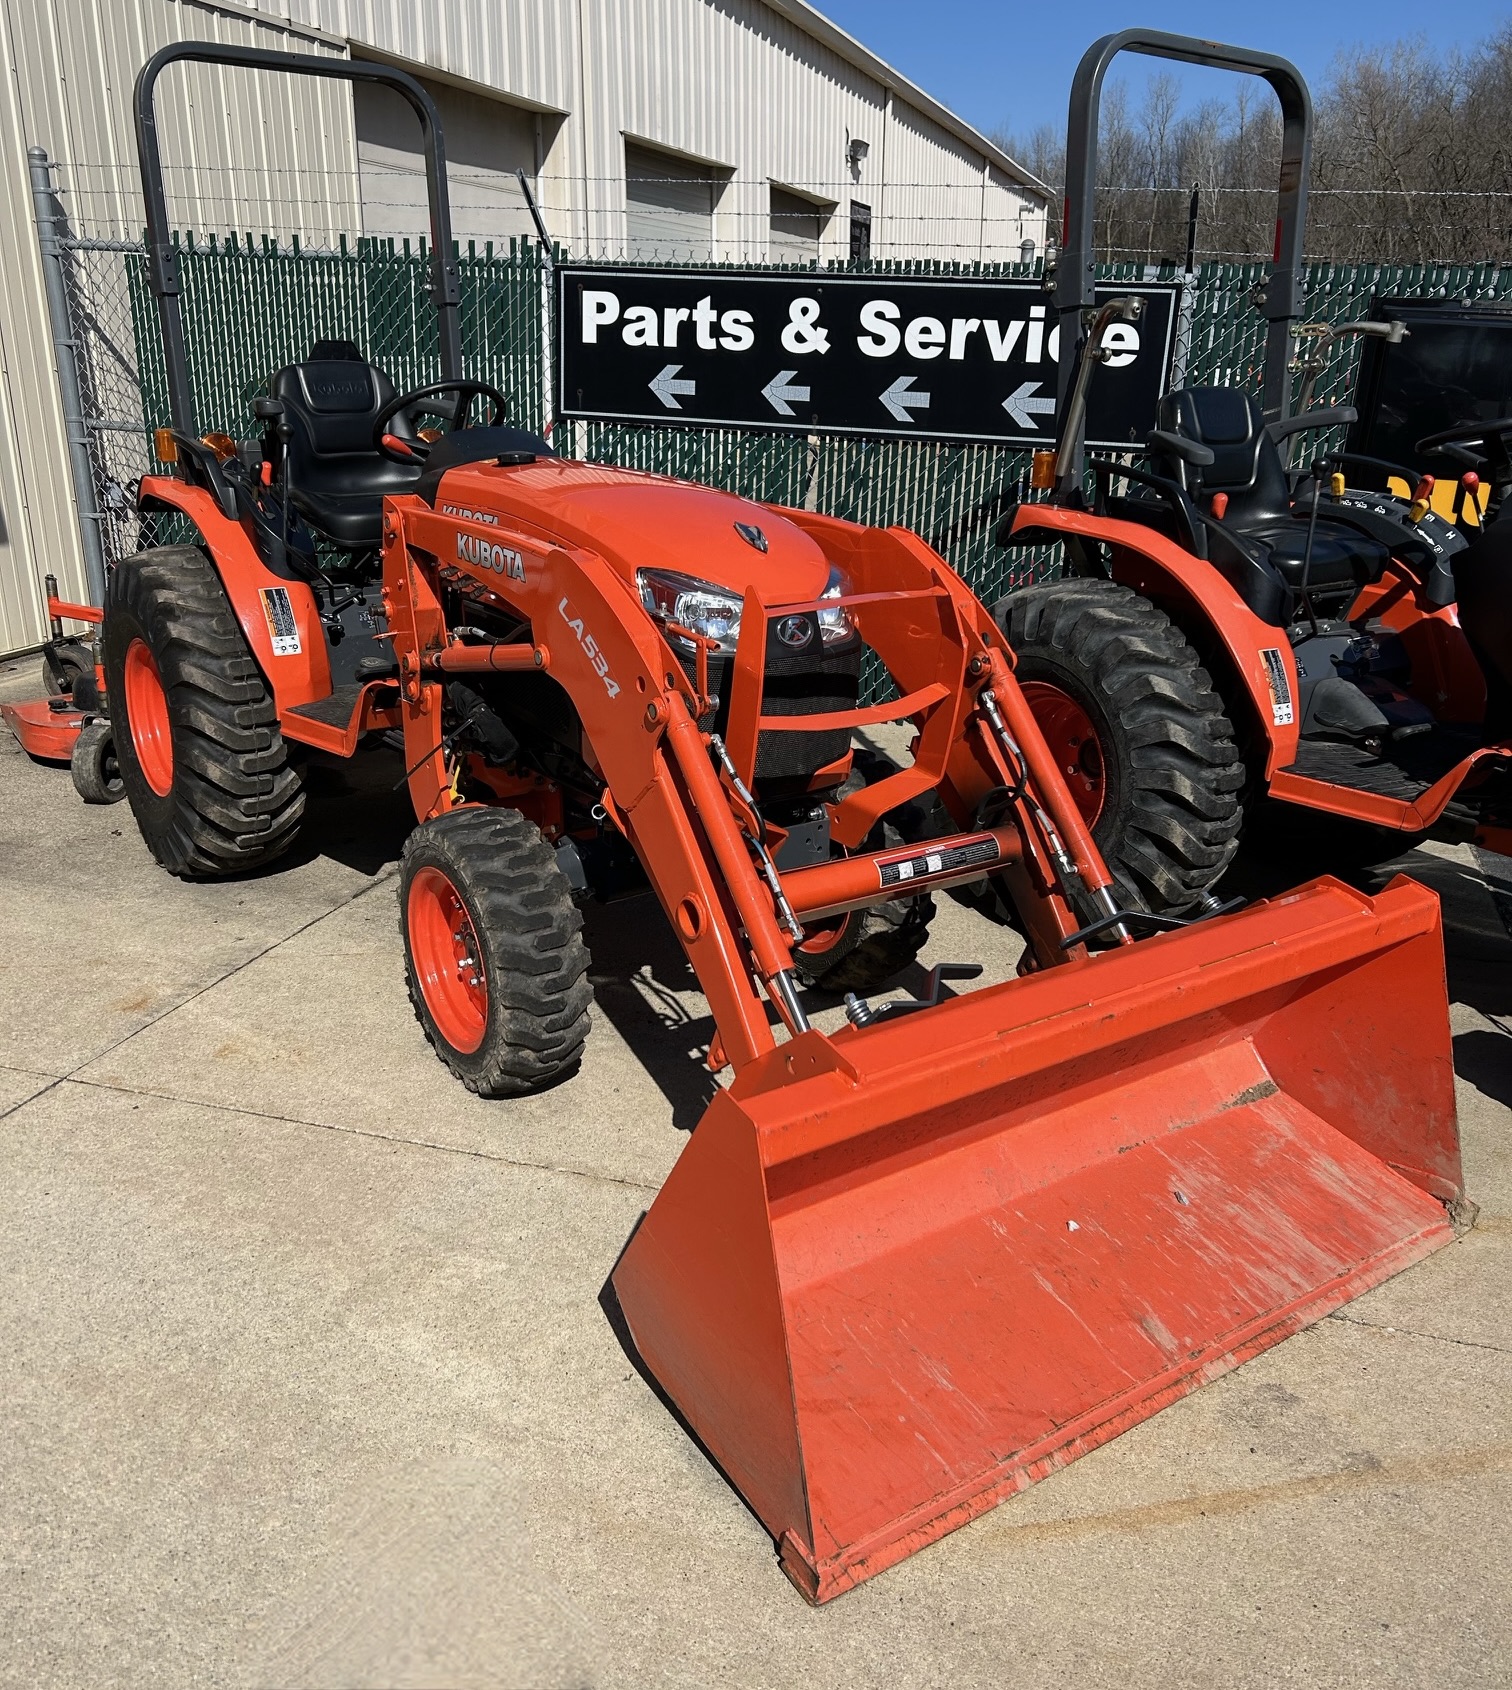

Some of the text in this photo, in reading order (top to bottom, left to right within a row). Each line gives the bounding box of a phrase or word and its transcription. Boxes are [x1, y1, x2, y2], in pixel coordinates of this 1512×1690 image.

[582, 290, 1141, 368] Parts & Servie
[456, 531, 526, 583] KUBOTA
[558, 597, 621, 699] LA534
